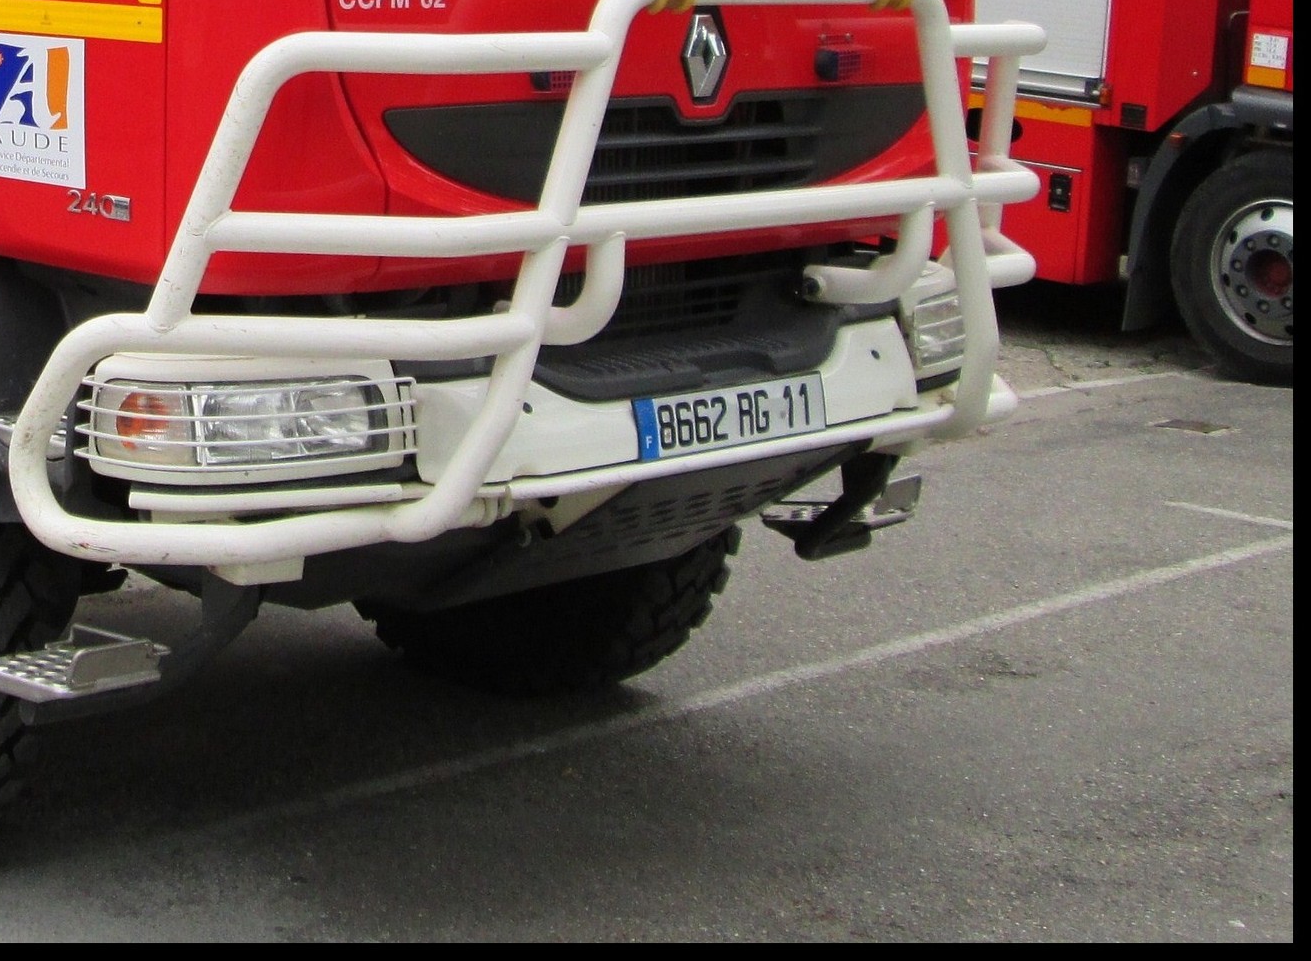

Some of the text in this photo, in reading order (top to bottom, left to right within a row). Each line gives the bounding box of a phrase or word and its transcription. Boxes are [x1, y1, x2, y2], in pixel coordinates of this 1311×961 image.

[67, 189, 115, 219] 240
[645, 383, 811, 451] F 8662 RG 11
